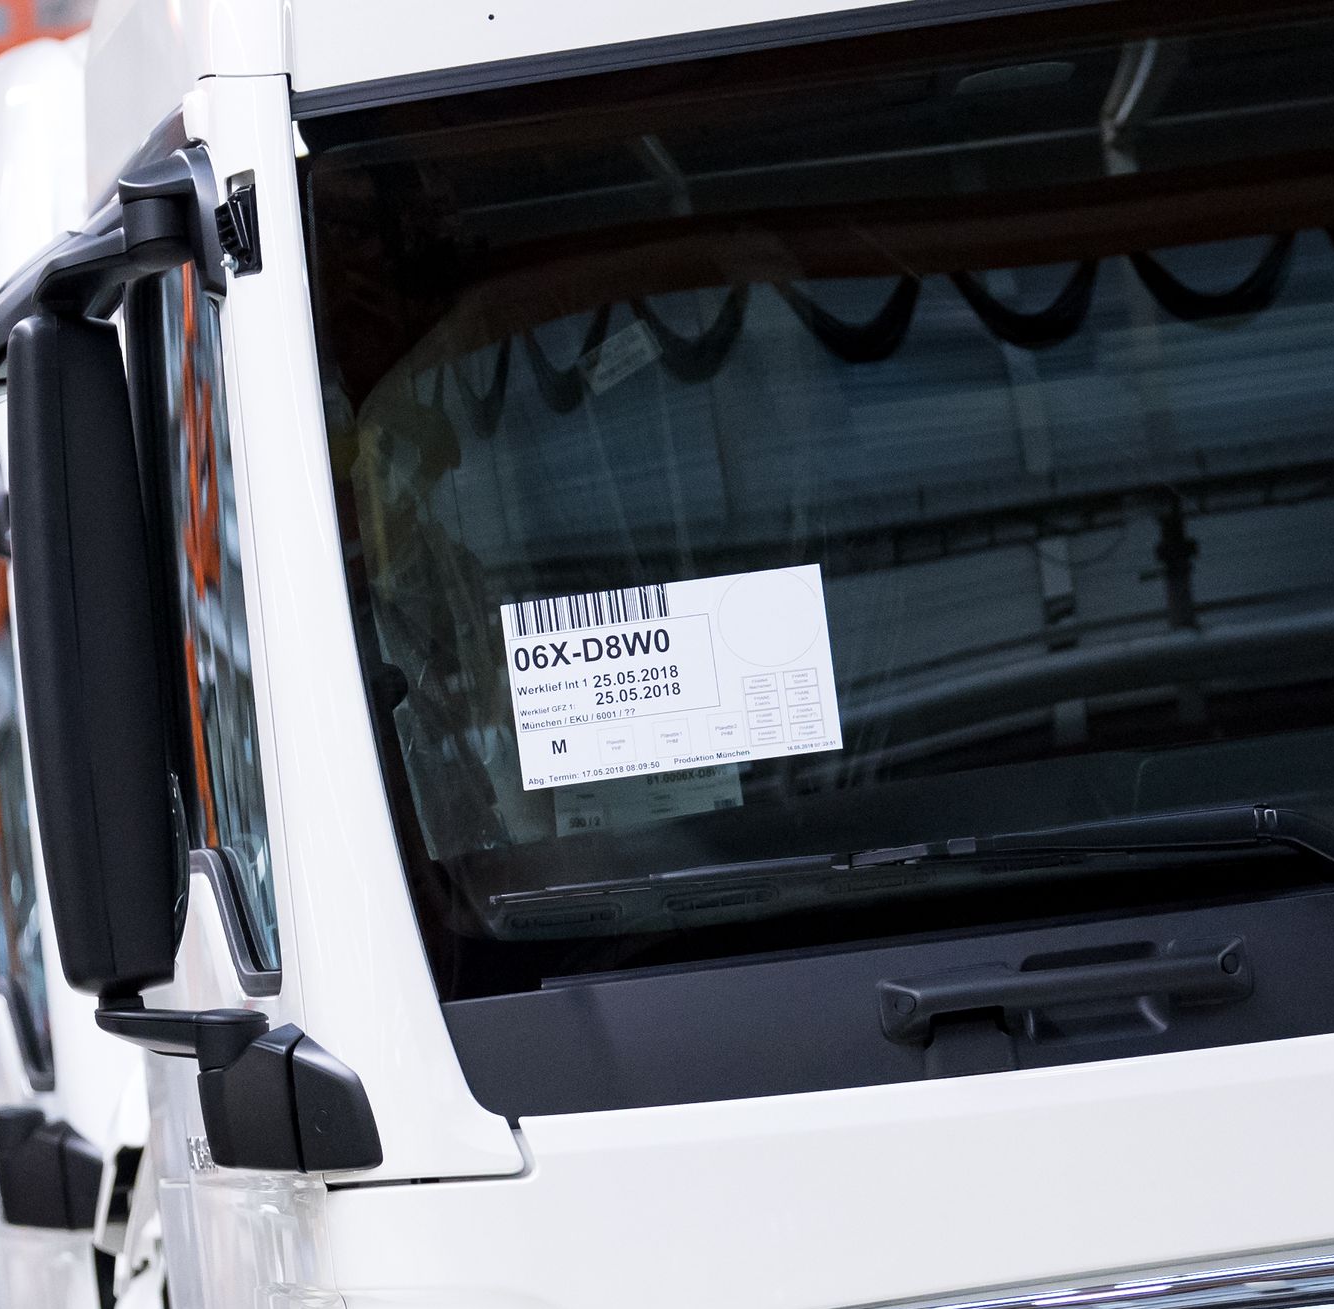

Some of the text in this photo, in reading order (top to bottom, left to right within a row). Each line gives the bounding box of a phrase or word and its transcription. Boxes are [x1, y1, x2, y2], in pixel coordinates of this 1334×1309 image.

[514, 628, 671, 672] 06X-D8W0
[517, 665, 679, 696] Werklief Int 1 25.05.2018
[595, 682, 681, 705] 25.05.2018
[520, 707, 550, 717] Werklief
[522, 719, 562, 730] München
[569, 715, 589, 724] EKU
[596, 711, 617, 720] 6001
[551, 739, 567, 755] M
[673, 748, 751, 765] Produktion München
[528, 761, 660, 786] Abg. Termin: 17.05.2018 08:09:50
